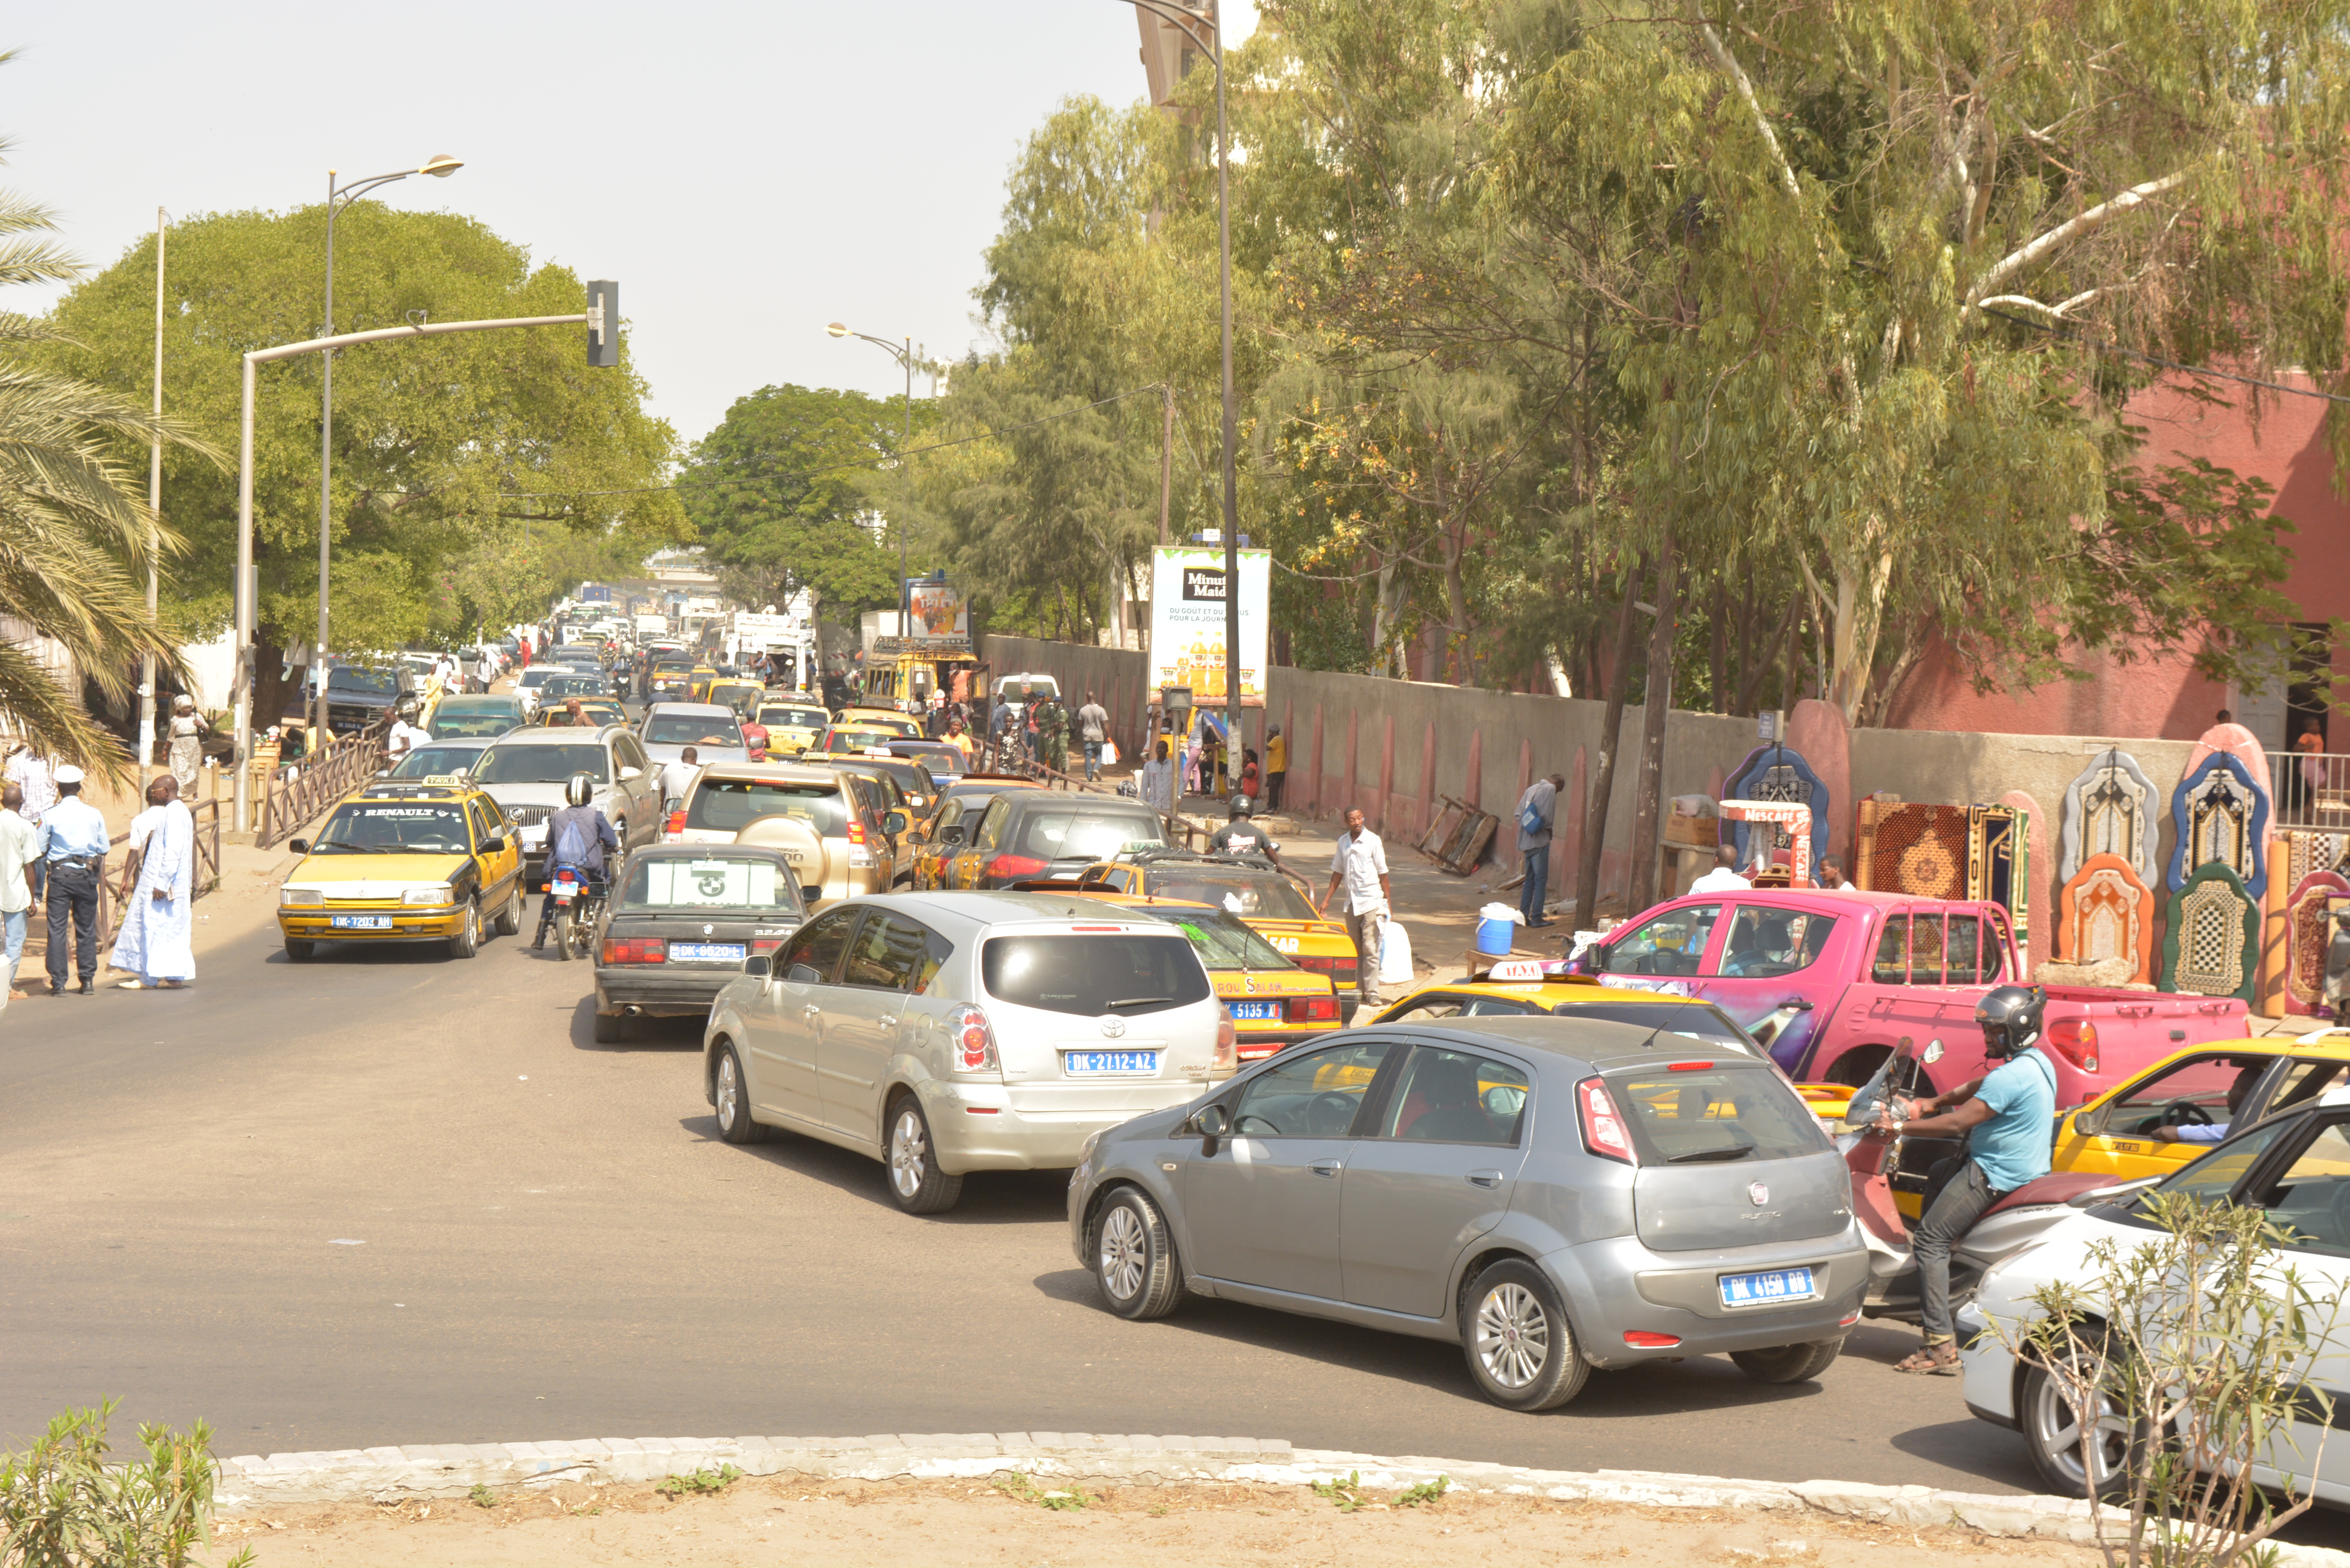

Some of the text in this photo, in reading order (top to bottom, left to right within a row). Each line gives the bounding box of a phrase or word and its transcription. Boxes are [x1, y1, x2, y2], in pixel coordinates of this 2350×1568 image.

[1194, 584, 1227, 597] Maid
[336, 917, 390, 927] DK-7203 AH
[1506, 965, 1538, 976] TAXI
[1245, 976, 1281, 994] SALAM
[1237, 1004, 1262, 1018] 5135
[1073, 1053, 1151, 1070] DK-2712-AZ
[1731, 1272, 1806, 1299] DK 4150 BB
